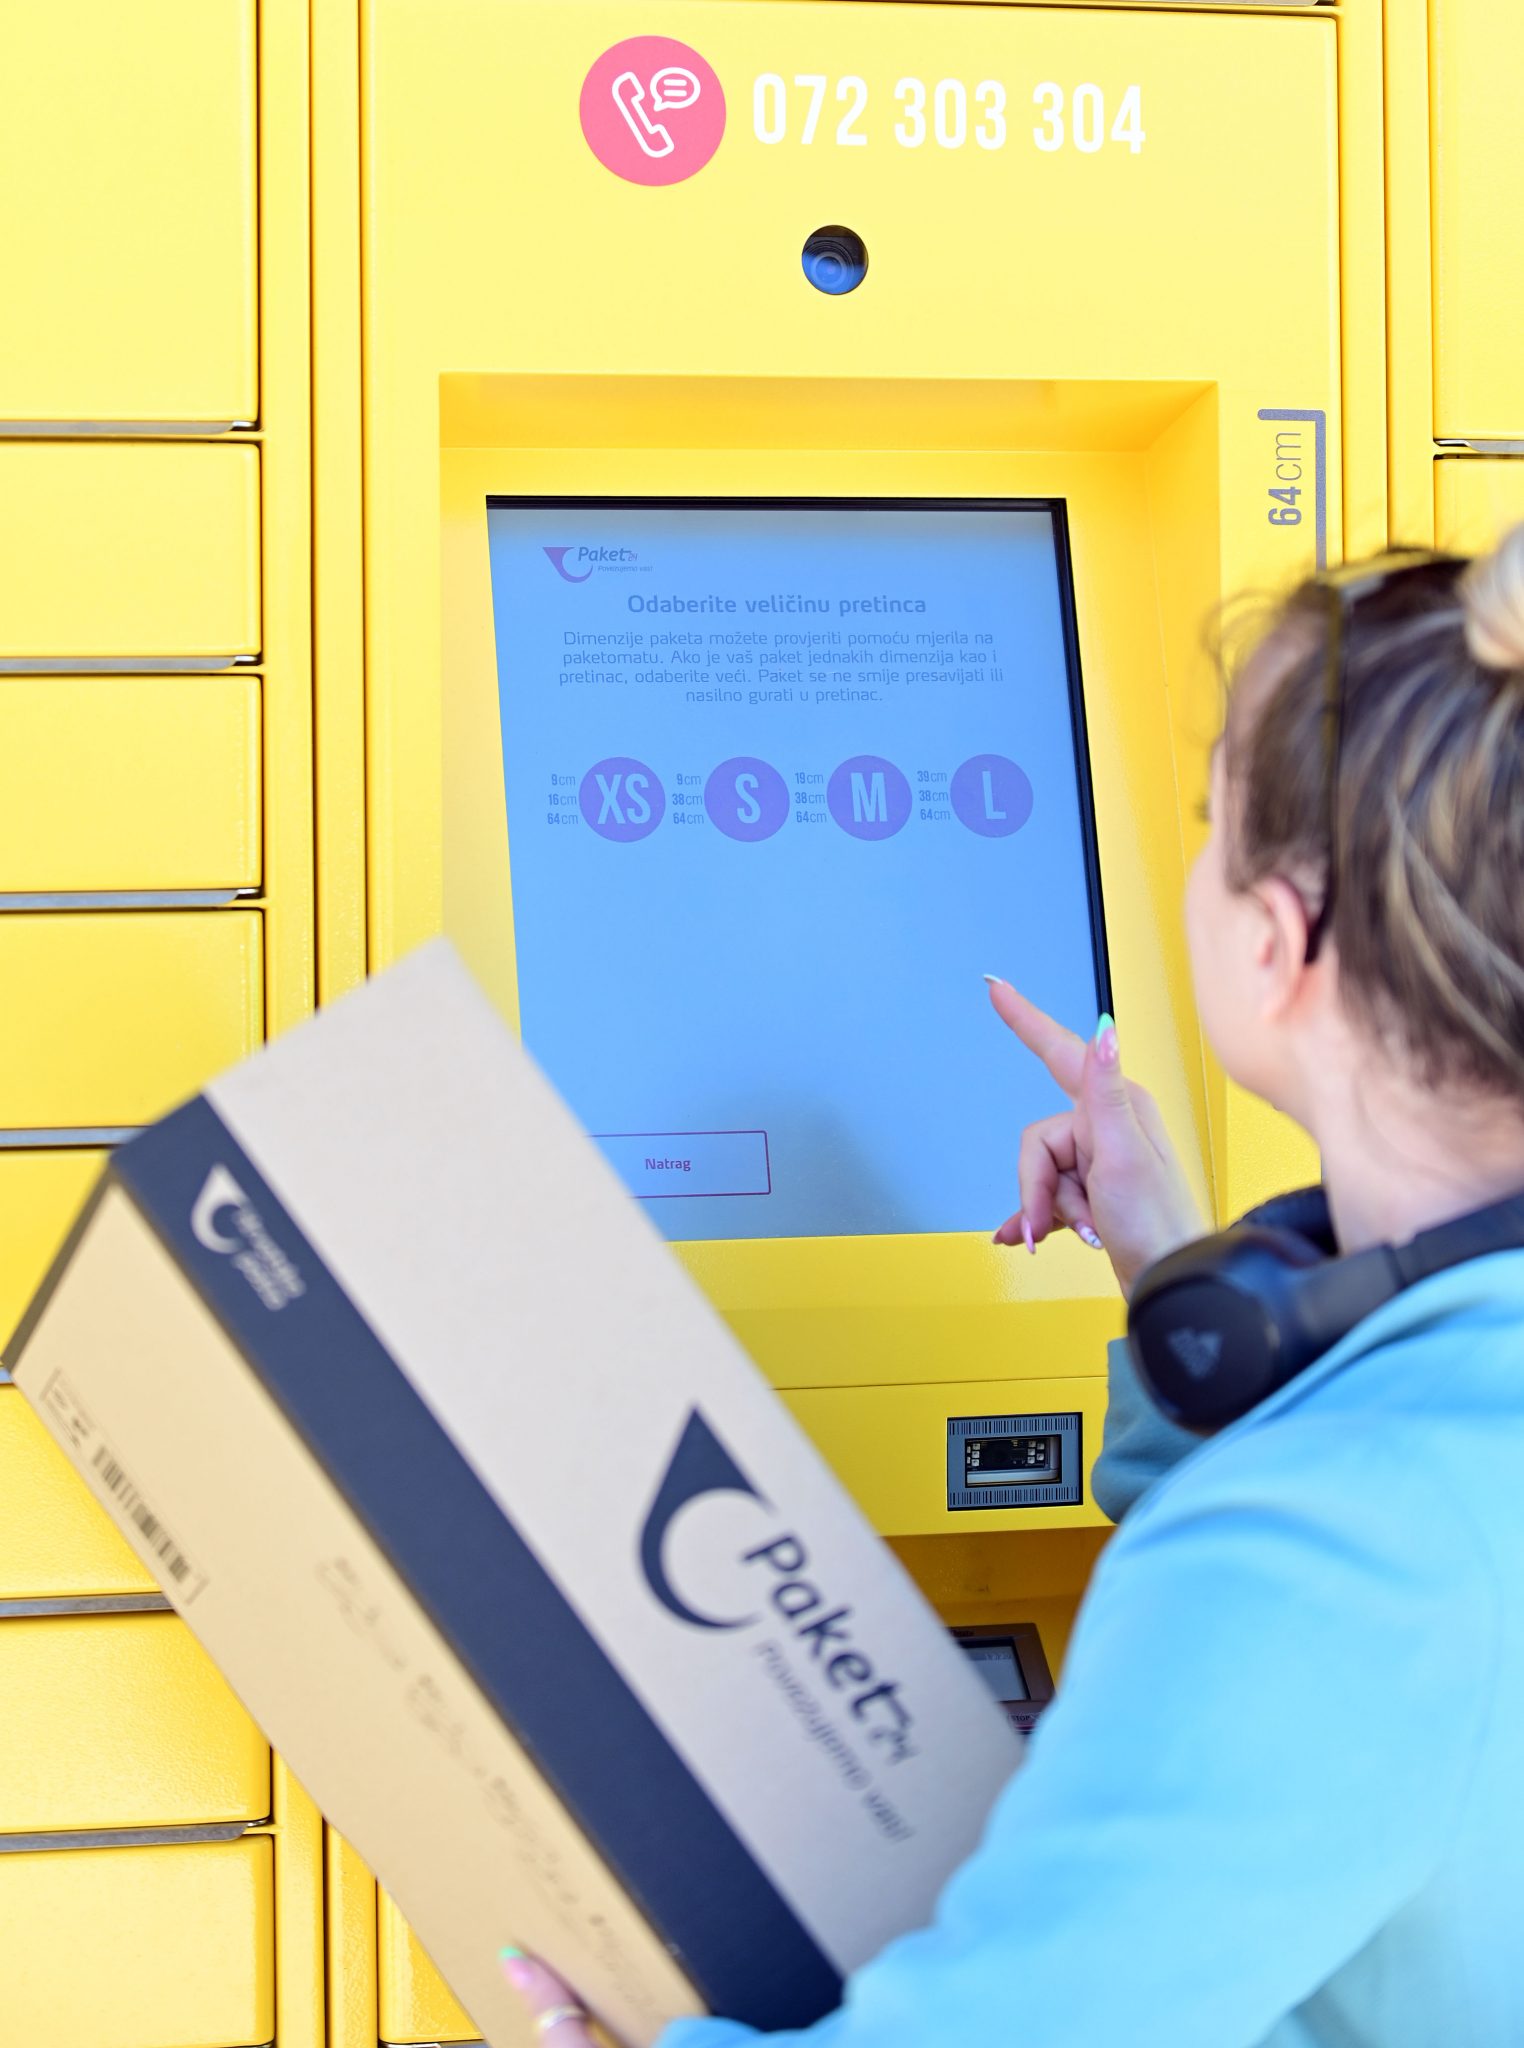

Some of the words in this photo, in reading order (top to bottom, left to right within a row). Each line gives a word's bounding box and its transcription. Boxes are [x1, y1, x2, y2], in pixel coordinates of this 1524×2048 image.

[753, 72, 868, 146] 072
[894, 77, 1006, 150] 303
[1033, 82, 1146, 154] 304
[627, 594, 737, 613] Odaberite
[745, 594, 830, 613] veličinu
[839, 595, 927, 617] pretinca
[563, 631, 644, 648] Dimenzije
[650, 632, 703, 648] paketa
[709, 631, 768, 645] možete
[774, 631, 841, 648] provjeriti
[848, 631, 910, 647] pomoću
[916, 631, 969, 647] mjerila
[975, 634, 994, 645] na
[563, 650, 664, 667] paketomatu.
[670, 650, 701, 664] Ako
[706, 650, 720, 667] je
[726, 650, 753, 664] vaš
[759, 650, 803, 667] paket
[807, 649, 874, 666] jednakih
[879, 649, 954, 666] dimenzija
[959, 649, 987, 663] kao
[559, 669, 628, 686] pretinac,
[635, 669, 709, 683] odaberite
[715, 669, 752, 683] veći.
[758, 669, 803, 683] Paket
[809, 672, 827, 682] se
[833, 671, 852, 682] ne
[858, 669, 900, 685] smije
[906, 669, 984, 685] presavijati
[990, 668, 1004, 682] ili
[686, 688, 742, 702] nasilno
[749, 688, 793, 704] gurati
[799, 690, 809, 702] u
[816, 688, 883, 704] pretinac.
[551, 773, 576, 786] 9cm
[676, 773, 702, 786] 9cm
[794, 772, 824, 785] 19cm
[917, 770, 948, 783] 39cm
[548, 793, 578, 806] 16cm
[594, 773, 652, 825] XS
[672, 793, 703, 806] 38cm
[735, 773, 761, 824] S
[795, 792, 825, 804] 38cm
[851, 771, 888, 823] M
[919, 790, 949, 802] 38cm
[982, 770, 1007, 820] L
[547, 813, 579, 825] 64cm
[673, 812, 705, 825] 64cm
[796, 811, 828, 824] 64cm
[920, 808, 951, 821] 64cm
[645, 1158, 691, 1172] Natrag
